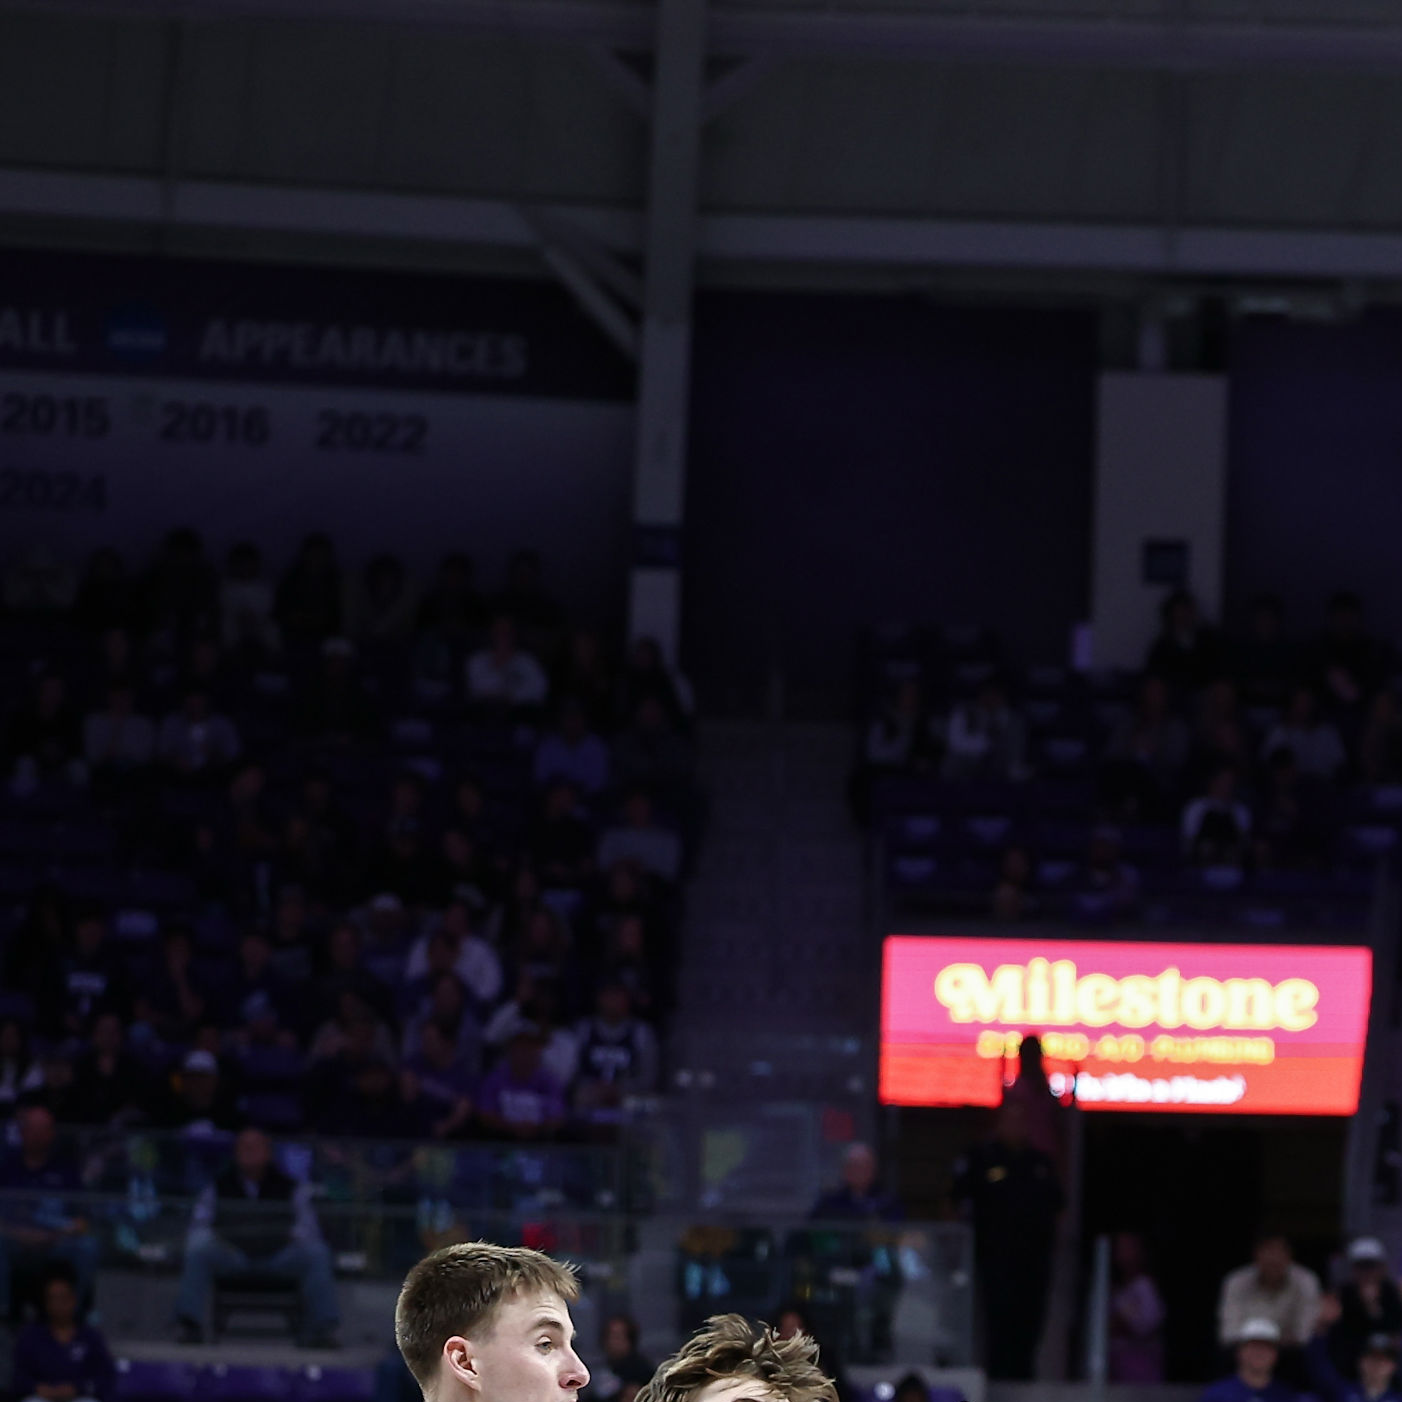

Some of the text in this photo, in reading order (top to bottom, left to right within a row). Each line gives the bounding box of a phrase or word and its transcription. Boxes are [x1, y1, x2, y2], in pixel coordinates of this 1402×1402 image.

[199, 320, 528, 378] APPEARANCES
[2, 394, 427, 454] 2015 2016 2022
[935, 957, 1319, 1031] Milestone
